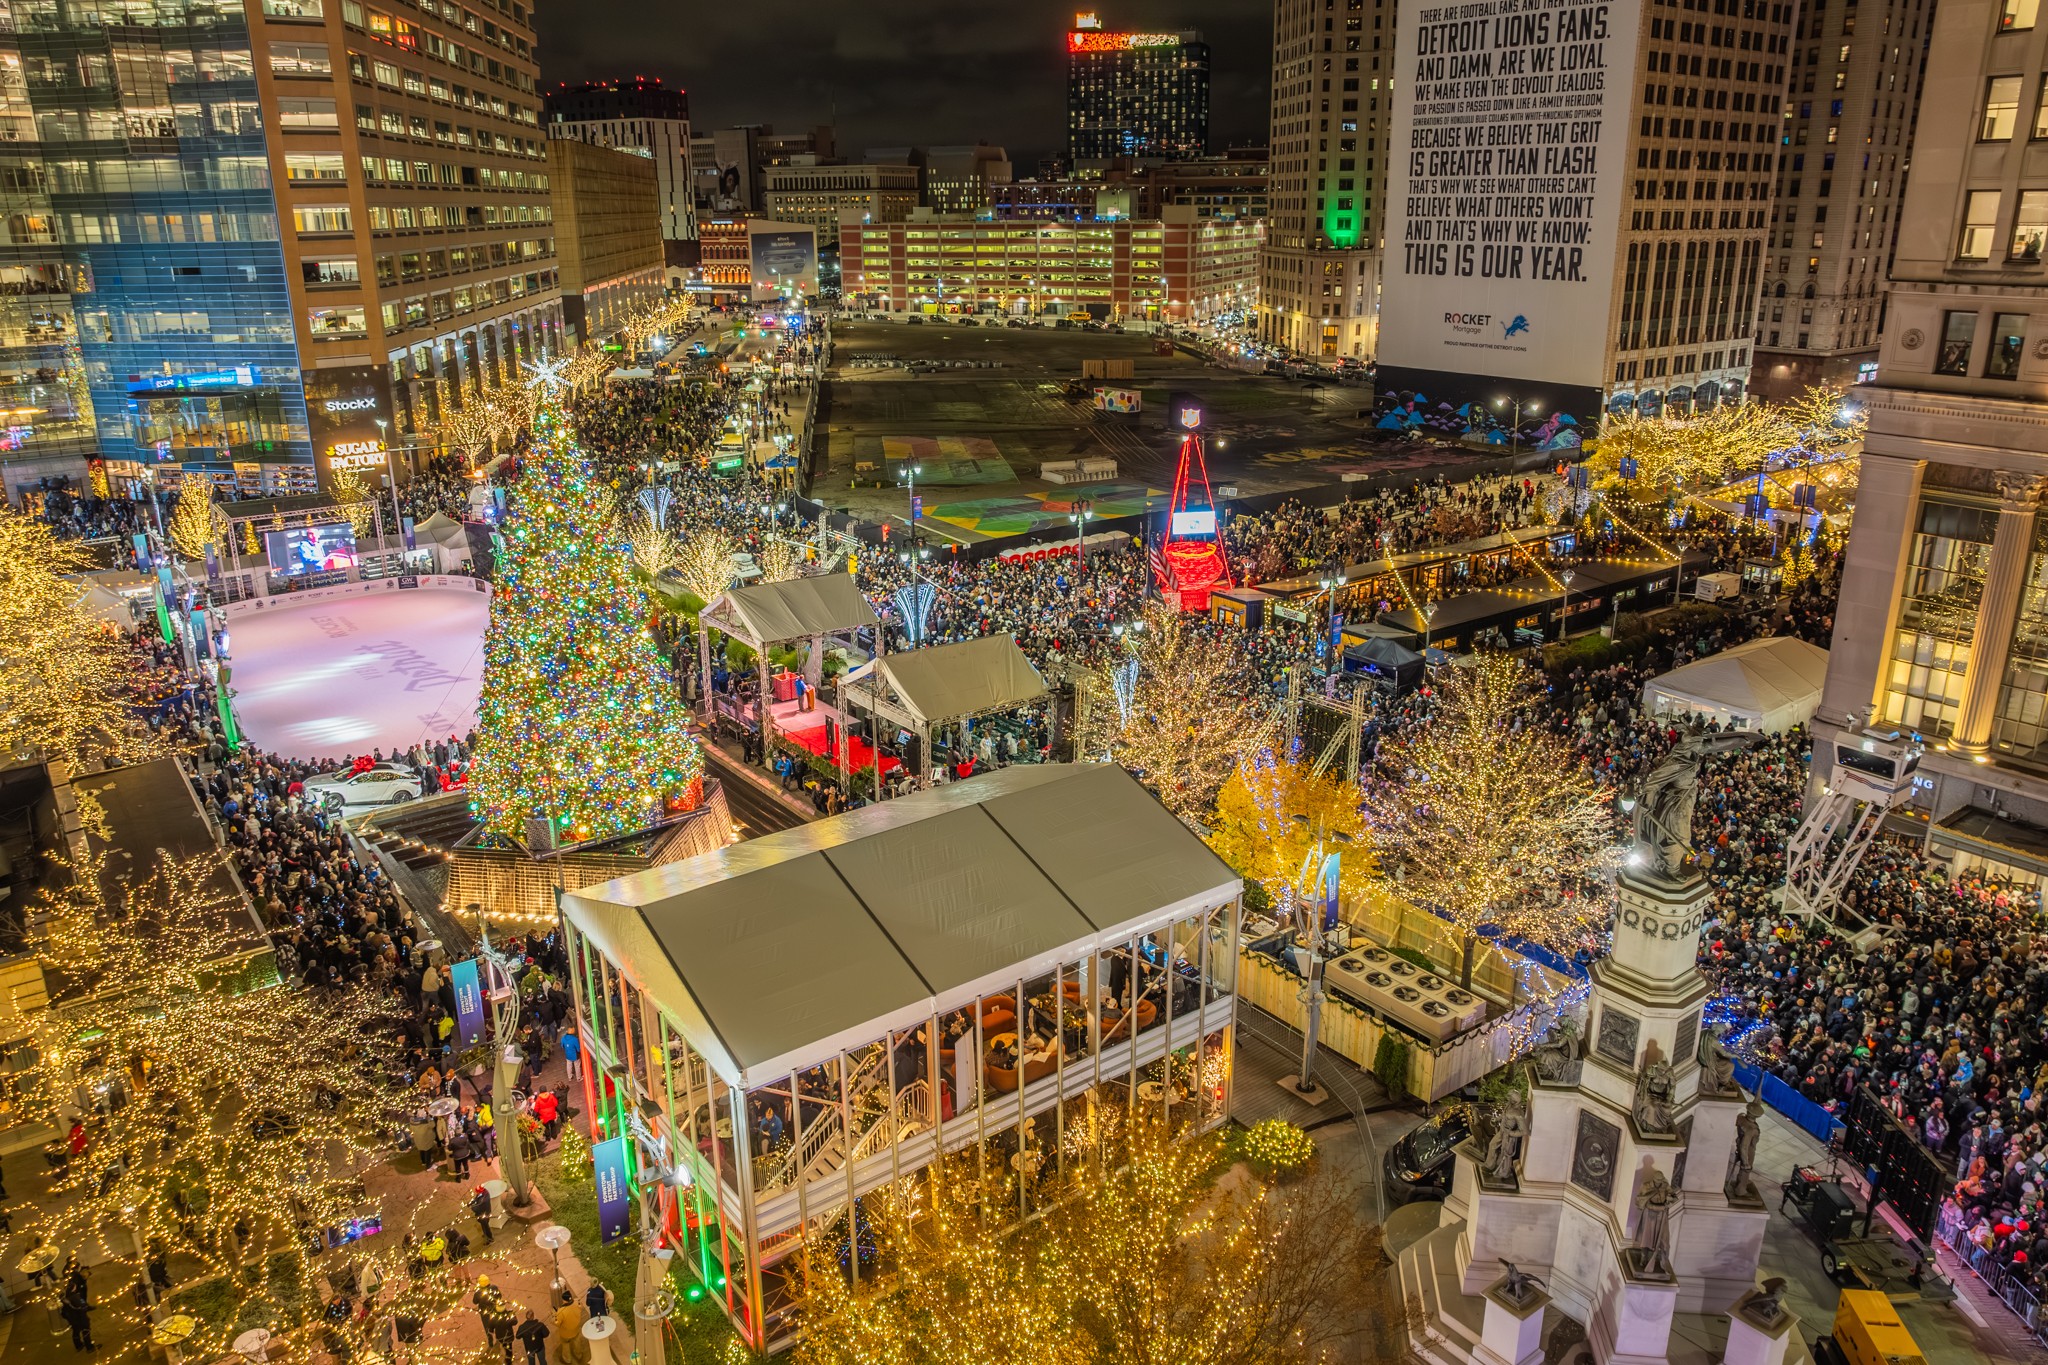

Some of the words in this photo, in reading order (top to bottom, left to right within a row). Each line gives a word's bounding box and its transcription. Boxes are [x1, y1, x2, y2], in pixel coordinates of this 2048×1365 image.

[1420, 8, 1442, 23] THERE
[1444, 8, 1458, 20] ARE
[1460, 2, 1497, 19] FOOTBALL
[1522, 0, 1540, 11] AND
[1417, 19, 1489, 56] DETROIT
[1494, 12, 1550, 48] LIONS
[1557, 6, 1611, 43] FANS.
[1416, 57, 1444, 82] AND
[1449, 53, 1494, 79] DAMN,
[1498, 49, 1526, 75] ARE
[1531, 46, 1556, 72] WE
[1560, 43, 1608, 71] LOYAL.
[1415, 82, 1430, 101] WE
[1434, 82, 1460, 100] MAKE
[1464, 81, 1488, 98] EVEN
[1491, 79, 1509, 96] THE
[1512, 75, 1553, 95] DEVOUT
[1556, 72, 1605, 92] JEALOUS.
[1414, 104, 1426, 115] OUR
[1429, 102, 1456, 114] PASSION
[1457, 102, 1464, 112] IS
[1466, 100, 1491, 112] PASSED
[1493, 99, 1514, 111] DOWN
[1516, 98, 1530, 109] LIKE
[1532, 99, 1537, 108] A
[1539, 96, 1564, 108] FAMILY
[1489, 114, 1508, 122] COLLARS
[1510, 113, 1523, 121] WITH
[1411, 127, 1461, 149] BECAUSE
[1465, 126, 1484, 147] WE
[1488, 124, 1532, 146] BELIEVE
[1536, 123, 1567, 144] THAT
[1570, 121, 1602, 143] GRIT
[1409, 151, 1424, 177] IS
[1430, 149, 1492, 177] GREATER
[1498, 147, 1539, 175] THAN
[1544, 146, 1597, 174] FLASH.
[1409, 179, 1437, 194] THAT'S
[1440, 179, 1460, 194] WHY
[1463, 178, 1477, 194] WE
[1480, 178, 1496, 194] SEE
[1498, 178, 1525, 194] WHAT
[1528, 178, 1564, 194] OTHERS
[1568, 177, 1596, 194] CAN'T.
[1407, 197, 1451, 217] BELIEVE
[1456, 196, 1492, 217] WHAT
[1495, 196, 1544, 218] OTHERS
[1550, 196, 1594, 218] WON'T.
[1405, 220, 1432, 241] AND
[1436, 220, 1476, 242] THAT'S
[1481, 220, 1512, 242] WHY
[1516, 221, 1537, 243] WE
[1542, 221, 1592, 244] KNOW:
[1405, 243, 1447, 276] THIS
[1455, 244, 1475, 277] IS
[1482, 245, 1523, 279] OUR
[1532, 246, 1587, 282] YEAR.
[1445, 313, 1491, 326] ROCKET
[1453, 325, 1481, 334] Mortgage
[325, 398, 376, 411] StockX
[335, 441, 379, 456] SUGAR
[329, 452, 386, 469] FACTORY
